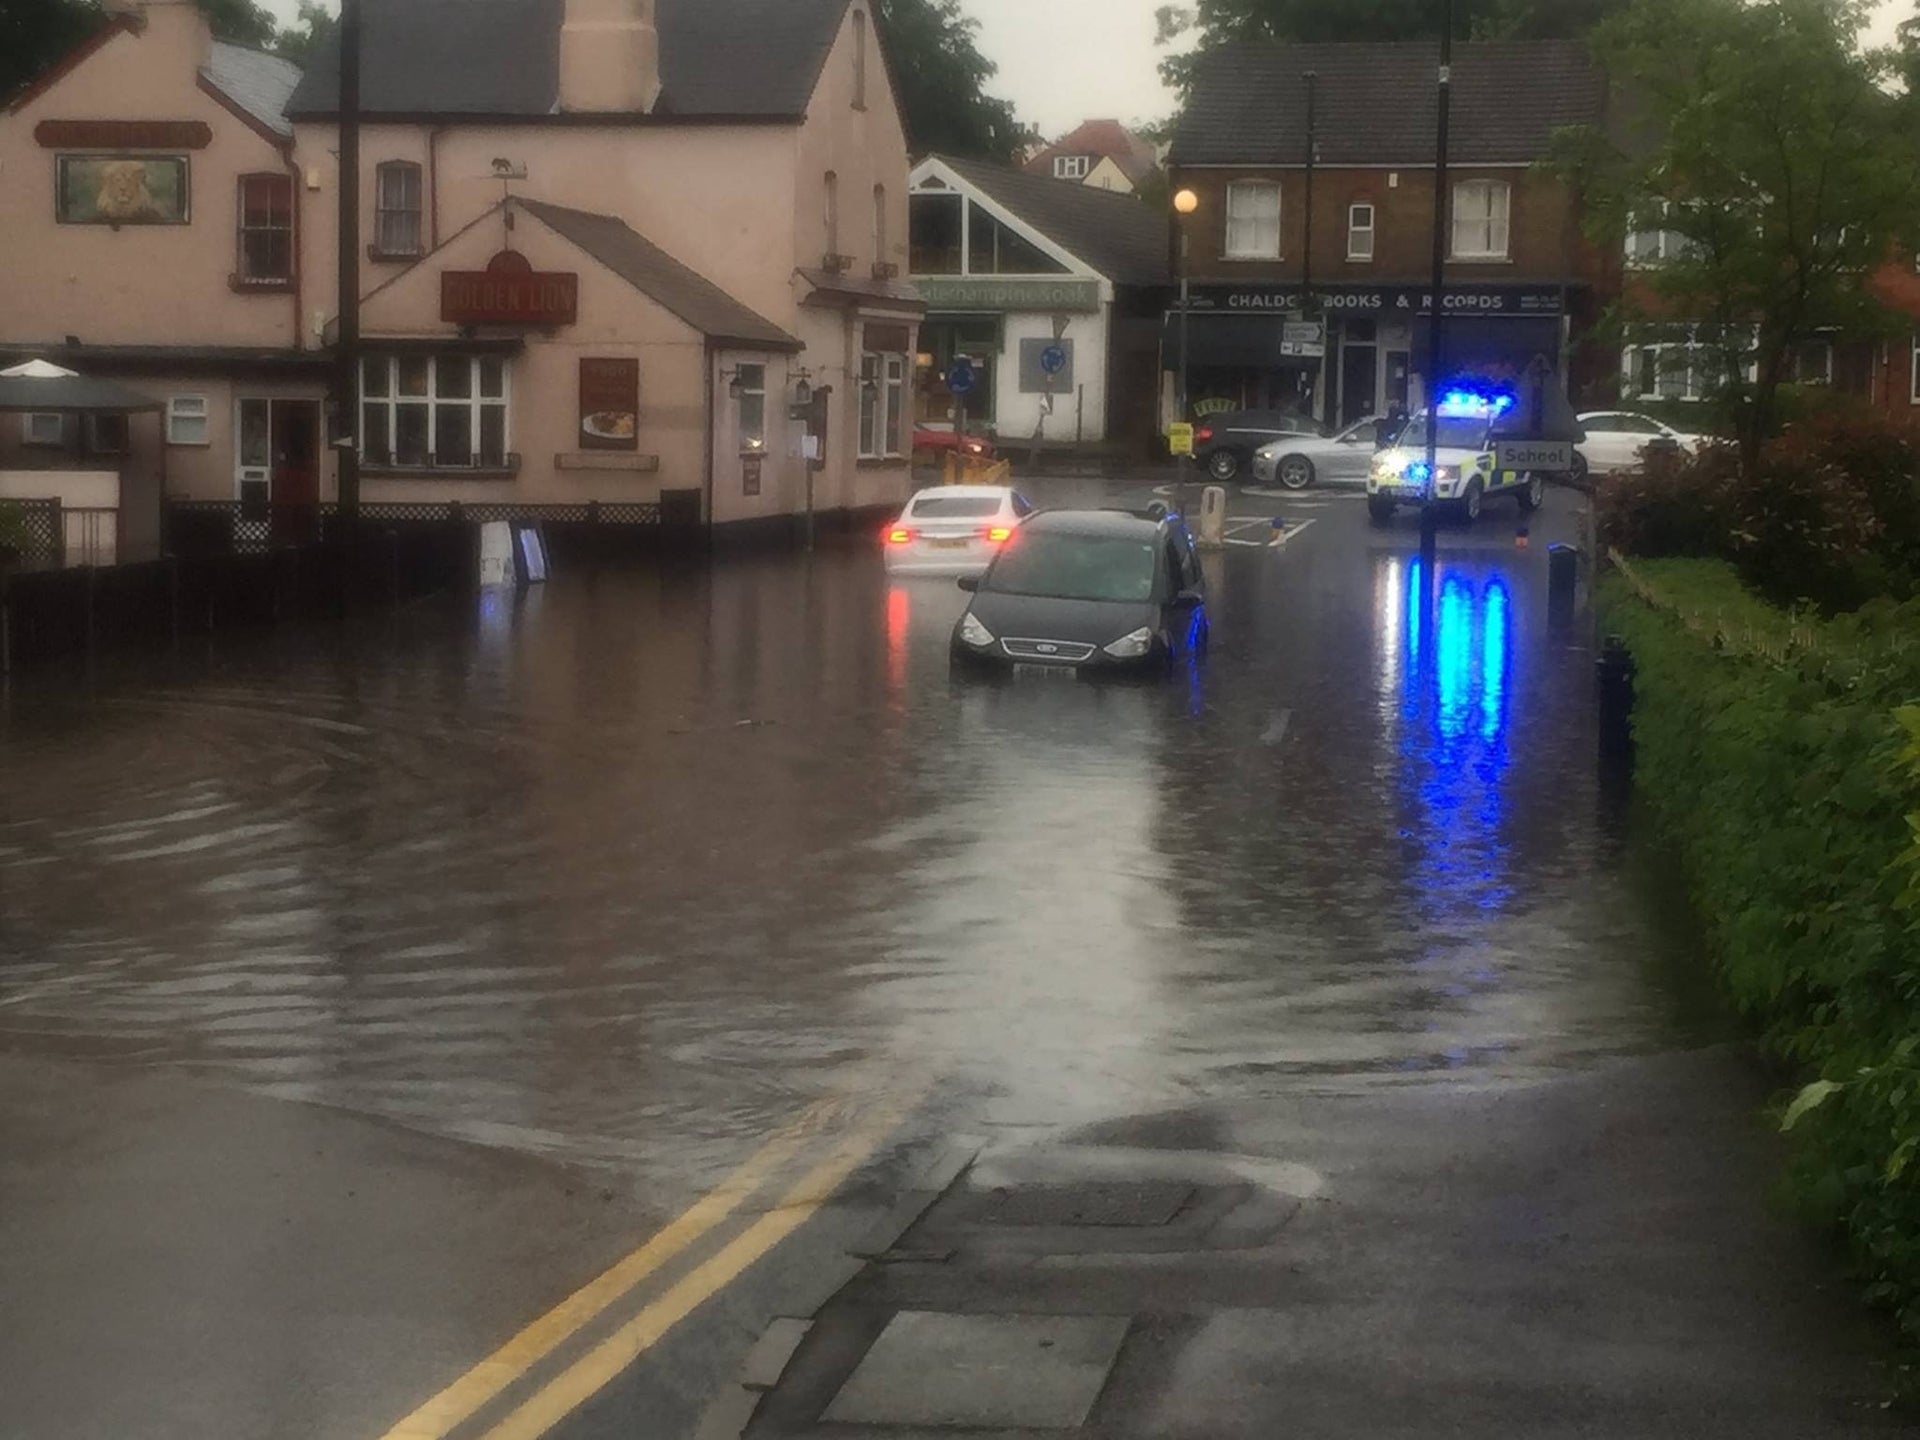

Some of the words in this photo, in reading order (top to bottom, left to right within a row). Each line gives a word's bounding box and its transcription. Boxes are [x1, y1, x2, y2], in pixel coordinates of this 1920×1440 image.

[445, 281, 520, 312] GOLDEN
[528, 281, 575, 313] LION
[1228, 295, 1297, 308] CHALDO
[1323, 294, 1382, 308] BOOKS
[1396, 295, 1409, 308] &
[1422, 294, 1503, 309] RCORDS
[1505, 447, 1564, 462] School
